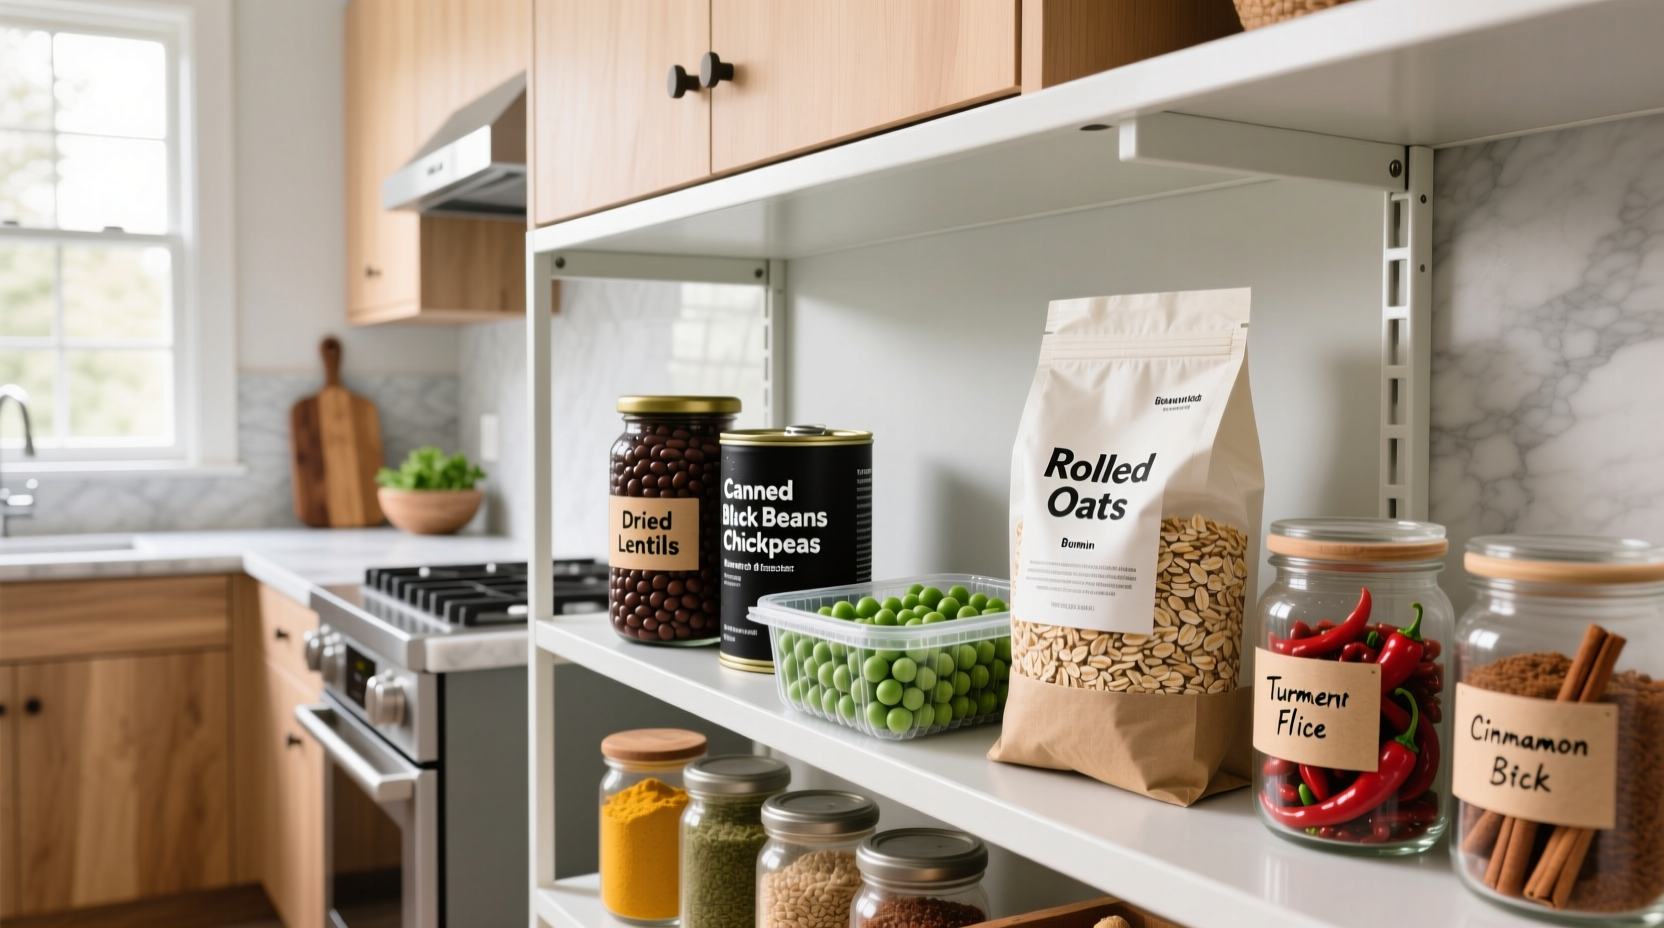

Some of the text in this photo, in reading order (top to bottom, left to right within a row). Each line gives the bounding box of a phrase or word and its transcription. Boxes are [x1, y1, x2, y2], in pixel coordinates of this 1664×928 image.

[1044, 447, 1157, 484] Rolled
[724, 478, 793, 501] Canned
[1048, 486, 1128, 520] Oats
[622, 510, 672, 530] Dried
[762, 506, 828, 528] Beans
[618, 534, 679, 555] Lentils
[724, 529, 821, 559] Chickpeas
[1277, 708, 1326, 739] Flice
[1490, 756, 1552, 793] Bick
